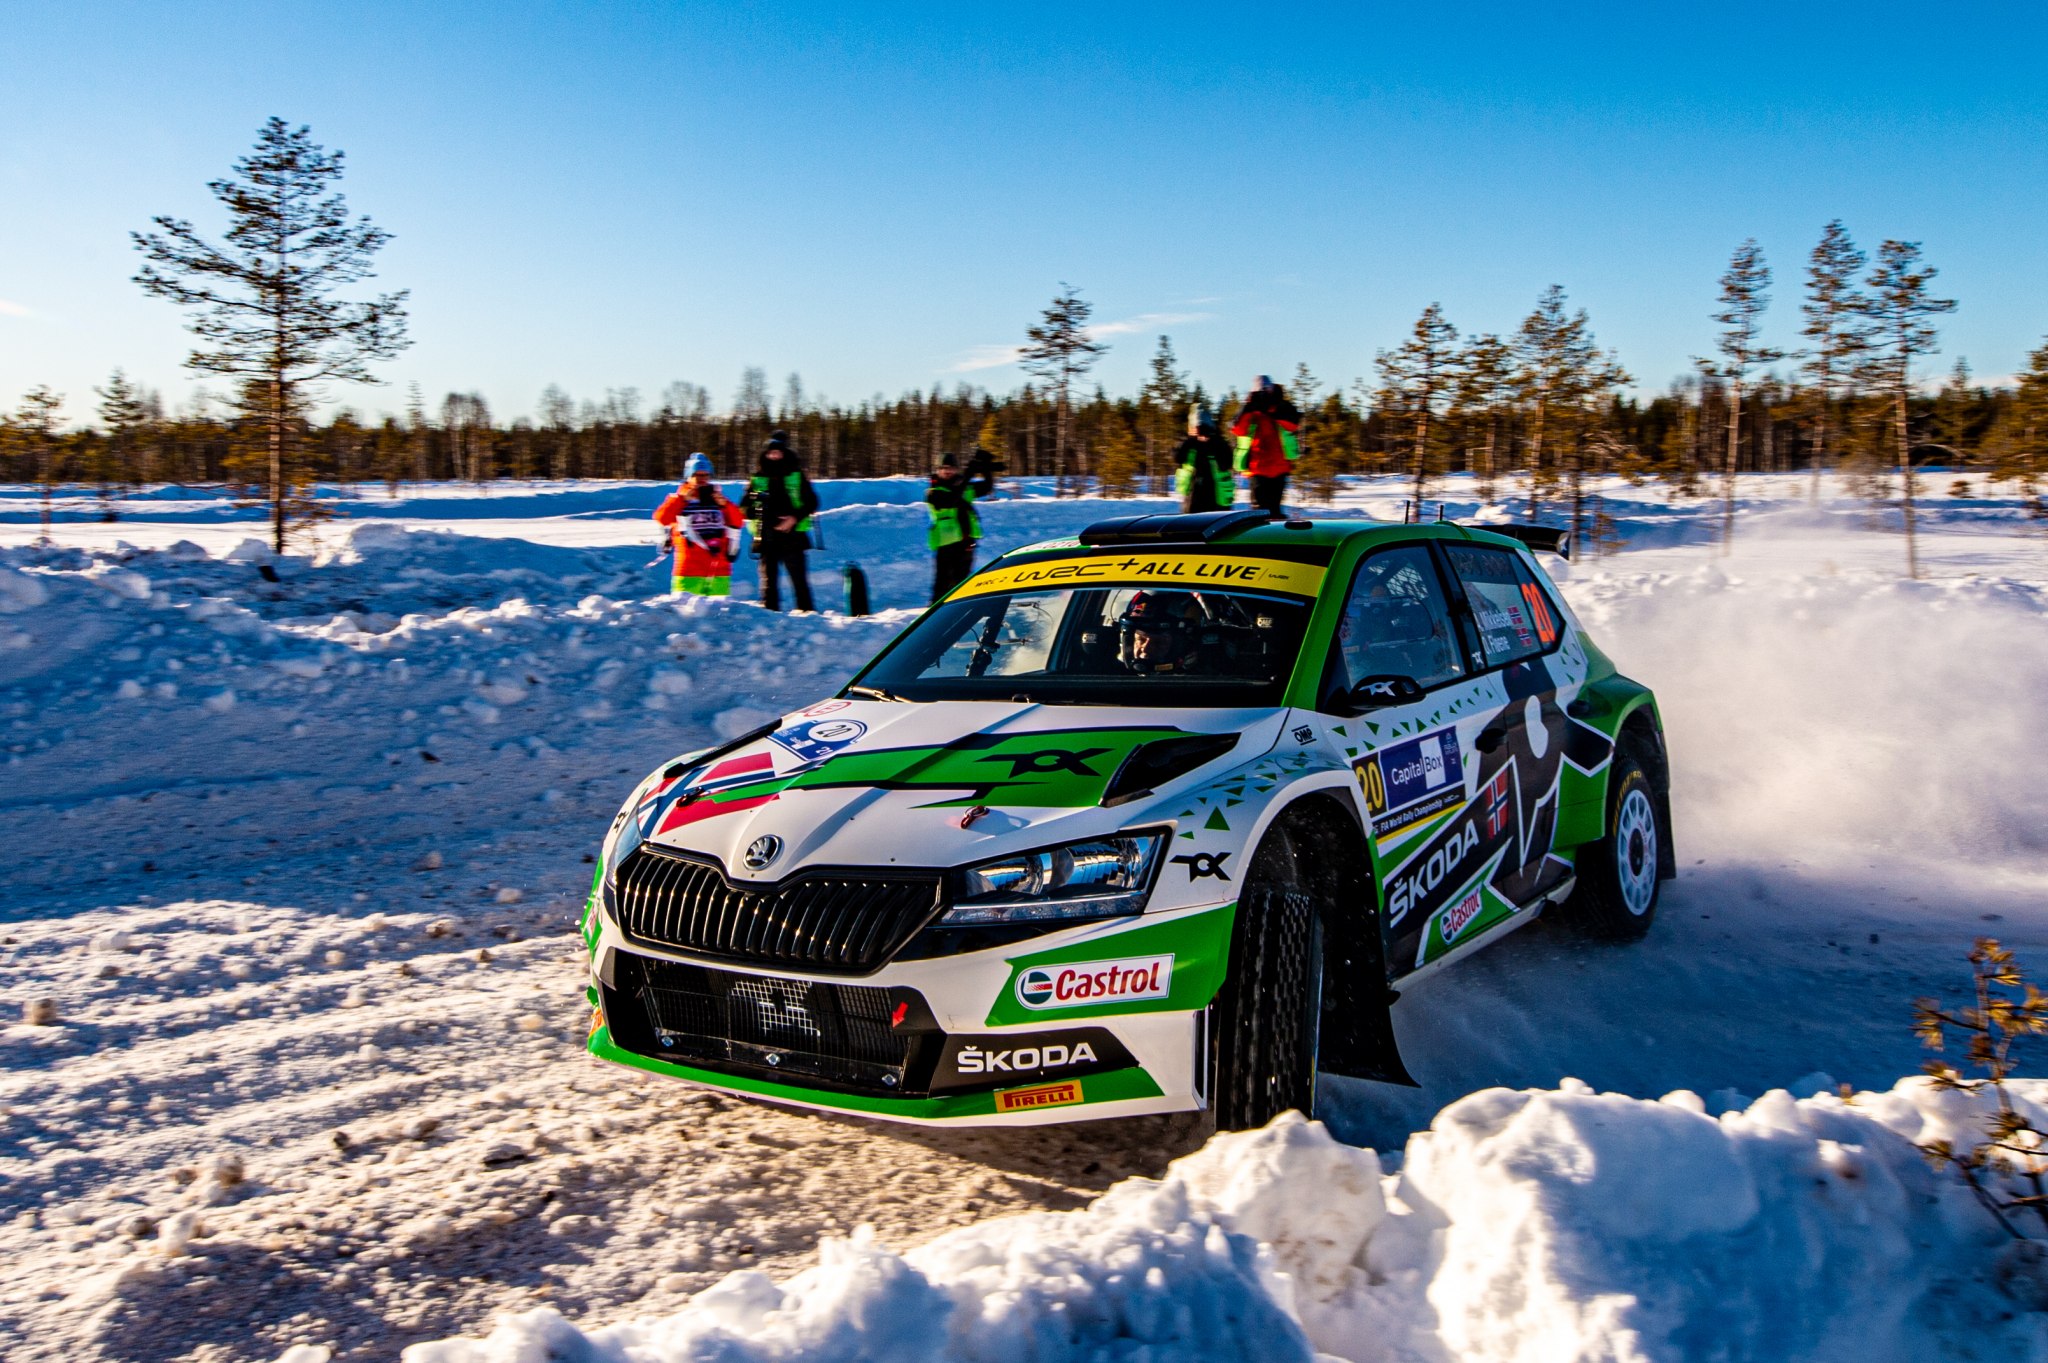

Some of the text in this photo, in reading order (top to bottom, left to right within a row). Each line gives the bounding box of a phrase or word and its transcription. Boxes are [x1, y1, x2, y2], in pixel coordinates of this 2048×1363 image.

[1136, 562, 1186, 576] ALL
[1195, 563, 1260, 580] LIVE
[1521, 583, 1556, 642] 20
[816, 725, 852, 738] 20
[1355, 761, 1383, 811] 20
[1390, 819, 1479, 928] ŠKODA
[1449, 887, 1481, 933] Castrol
[1055, 962, 1160, 1001] Castrol
[957, 1042, 1098, 1073] ŠKODA
[1004, 1084, 1075, 1108] PIRELLI
